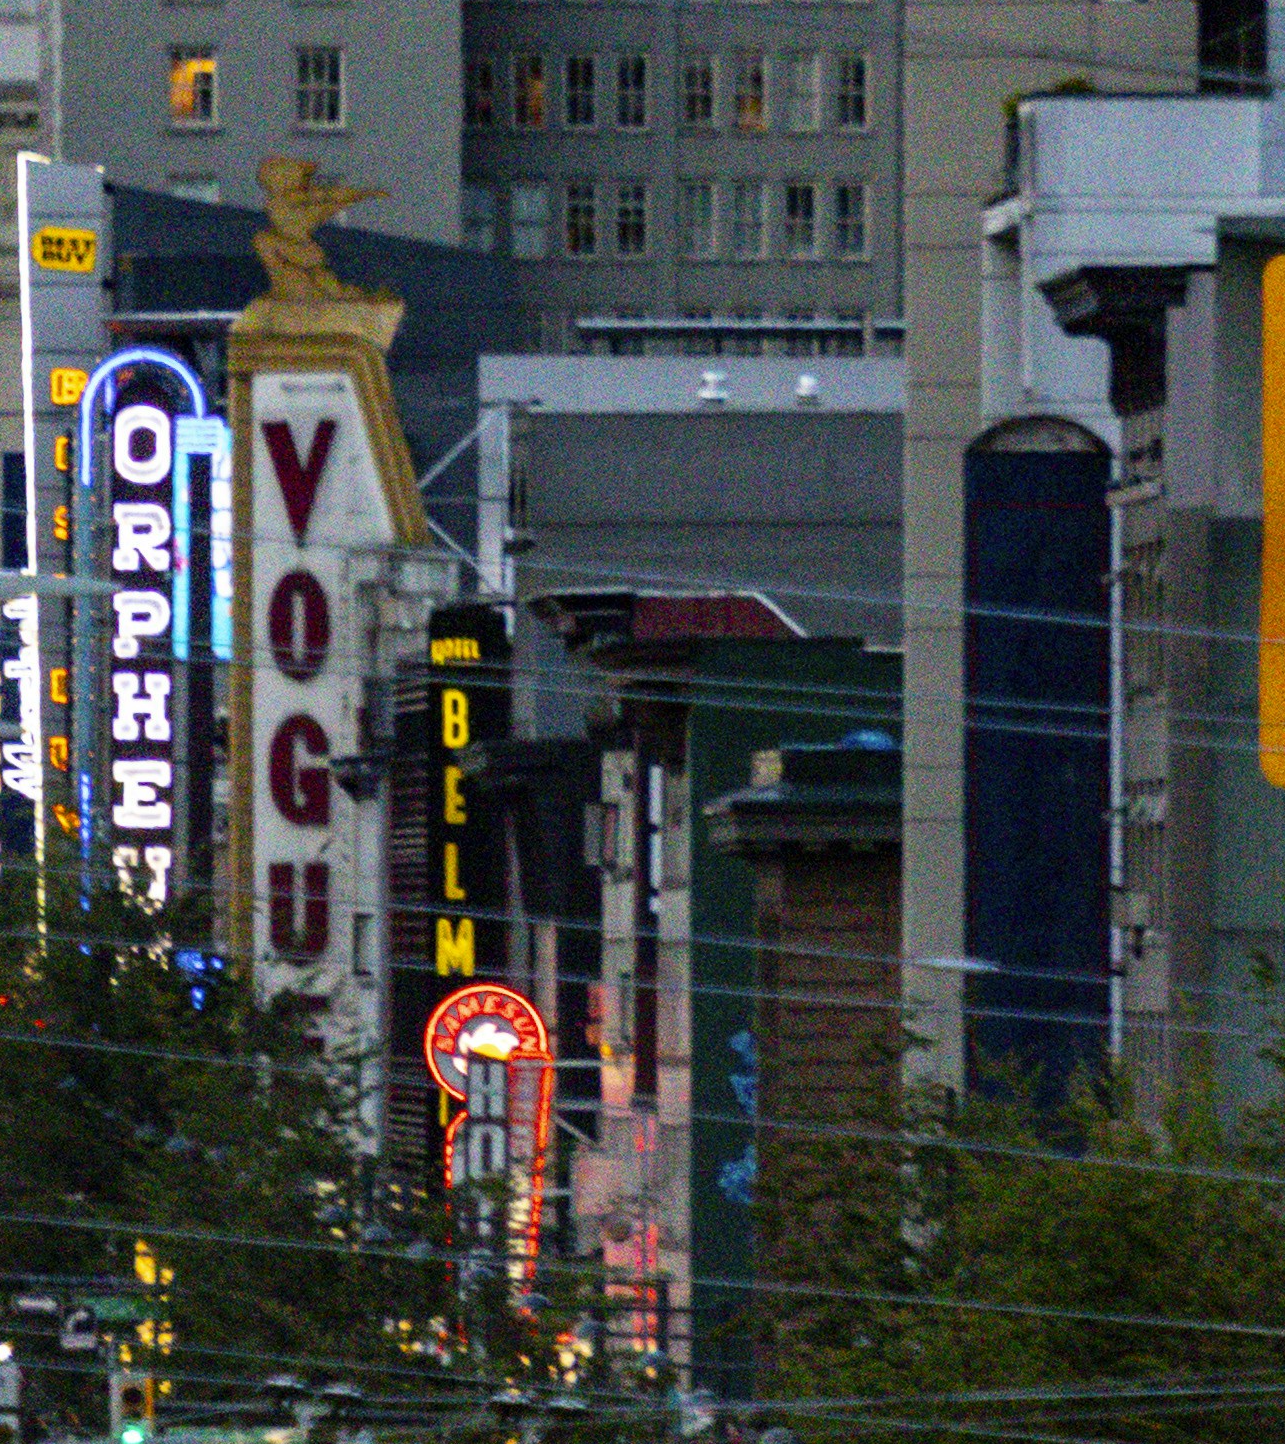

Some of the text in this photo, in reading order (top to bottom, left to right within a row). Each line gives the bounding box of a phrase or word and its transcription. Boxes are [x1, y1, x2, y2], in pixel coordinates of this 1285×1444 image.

[111, 403, 174, 920] ORPHEU
[261, 420, 336, 960] VOGU
[436, 688, 476, 978] BELM
